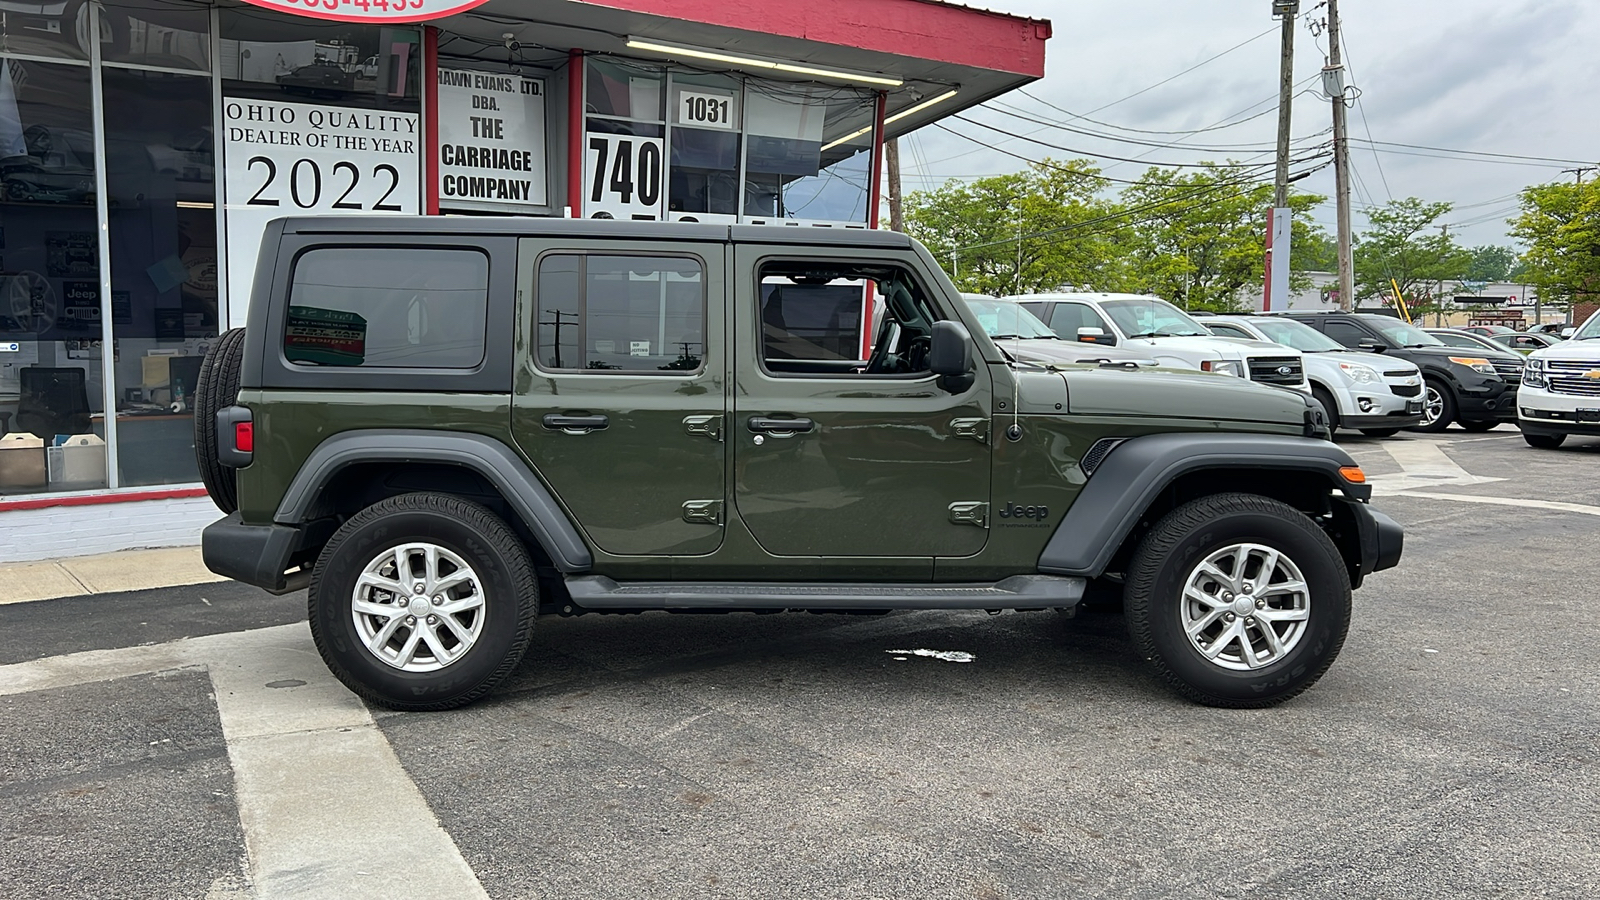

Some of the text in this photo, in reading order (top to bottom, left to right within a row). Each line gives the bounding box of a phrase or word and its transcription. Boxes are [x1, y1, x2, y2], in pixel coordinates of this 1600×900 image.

[474, 75, 515, 93] EVANS.
[520, 80, 542, 96] LTD.
[472, 94, 500, 111] DBA.
[686, 96, 729, 124] 1031
[226, 103, 417, 134] OHIO QUALITY
[469, 116, 504, 140] THE
[229, 127, 415, 154] DEALER OF THE YEAR
[441, 144, 532, 172] CARRIAGE
[246, 155, 402, 212] 2022
[589, 137, 660, 207] 740
[443, 174, 532, 201] COMPANY
[66, 288, 97, 300] Jeep
[999, 501, 1049, 522] Jeep
